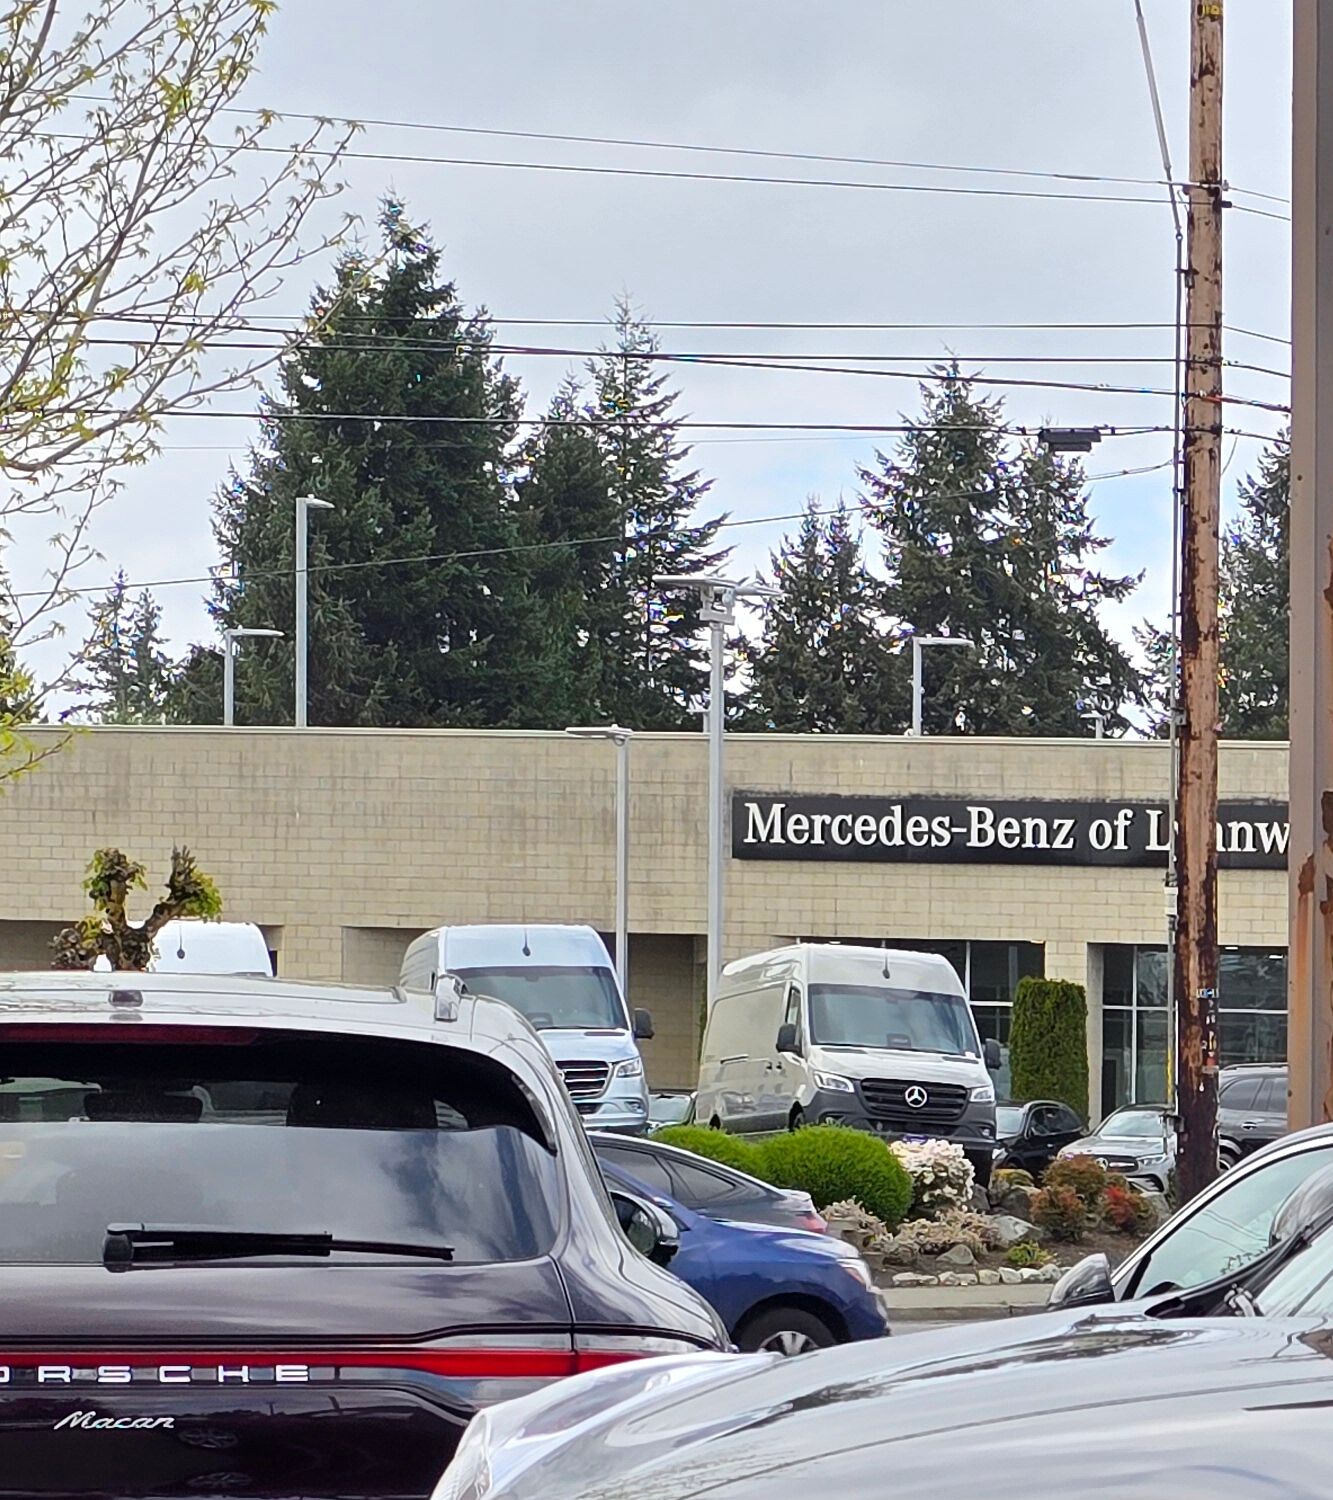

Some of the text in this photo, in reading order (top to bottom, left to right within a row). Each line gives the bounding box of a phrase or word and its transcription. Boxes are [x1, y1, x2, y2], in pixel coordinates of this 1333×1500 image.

[743, 802, 1076, 850] Mercedes-Benz
[1089, 809, 1134, 851] of
[53, 1411, 175, 1430] Macan
